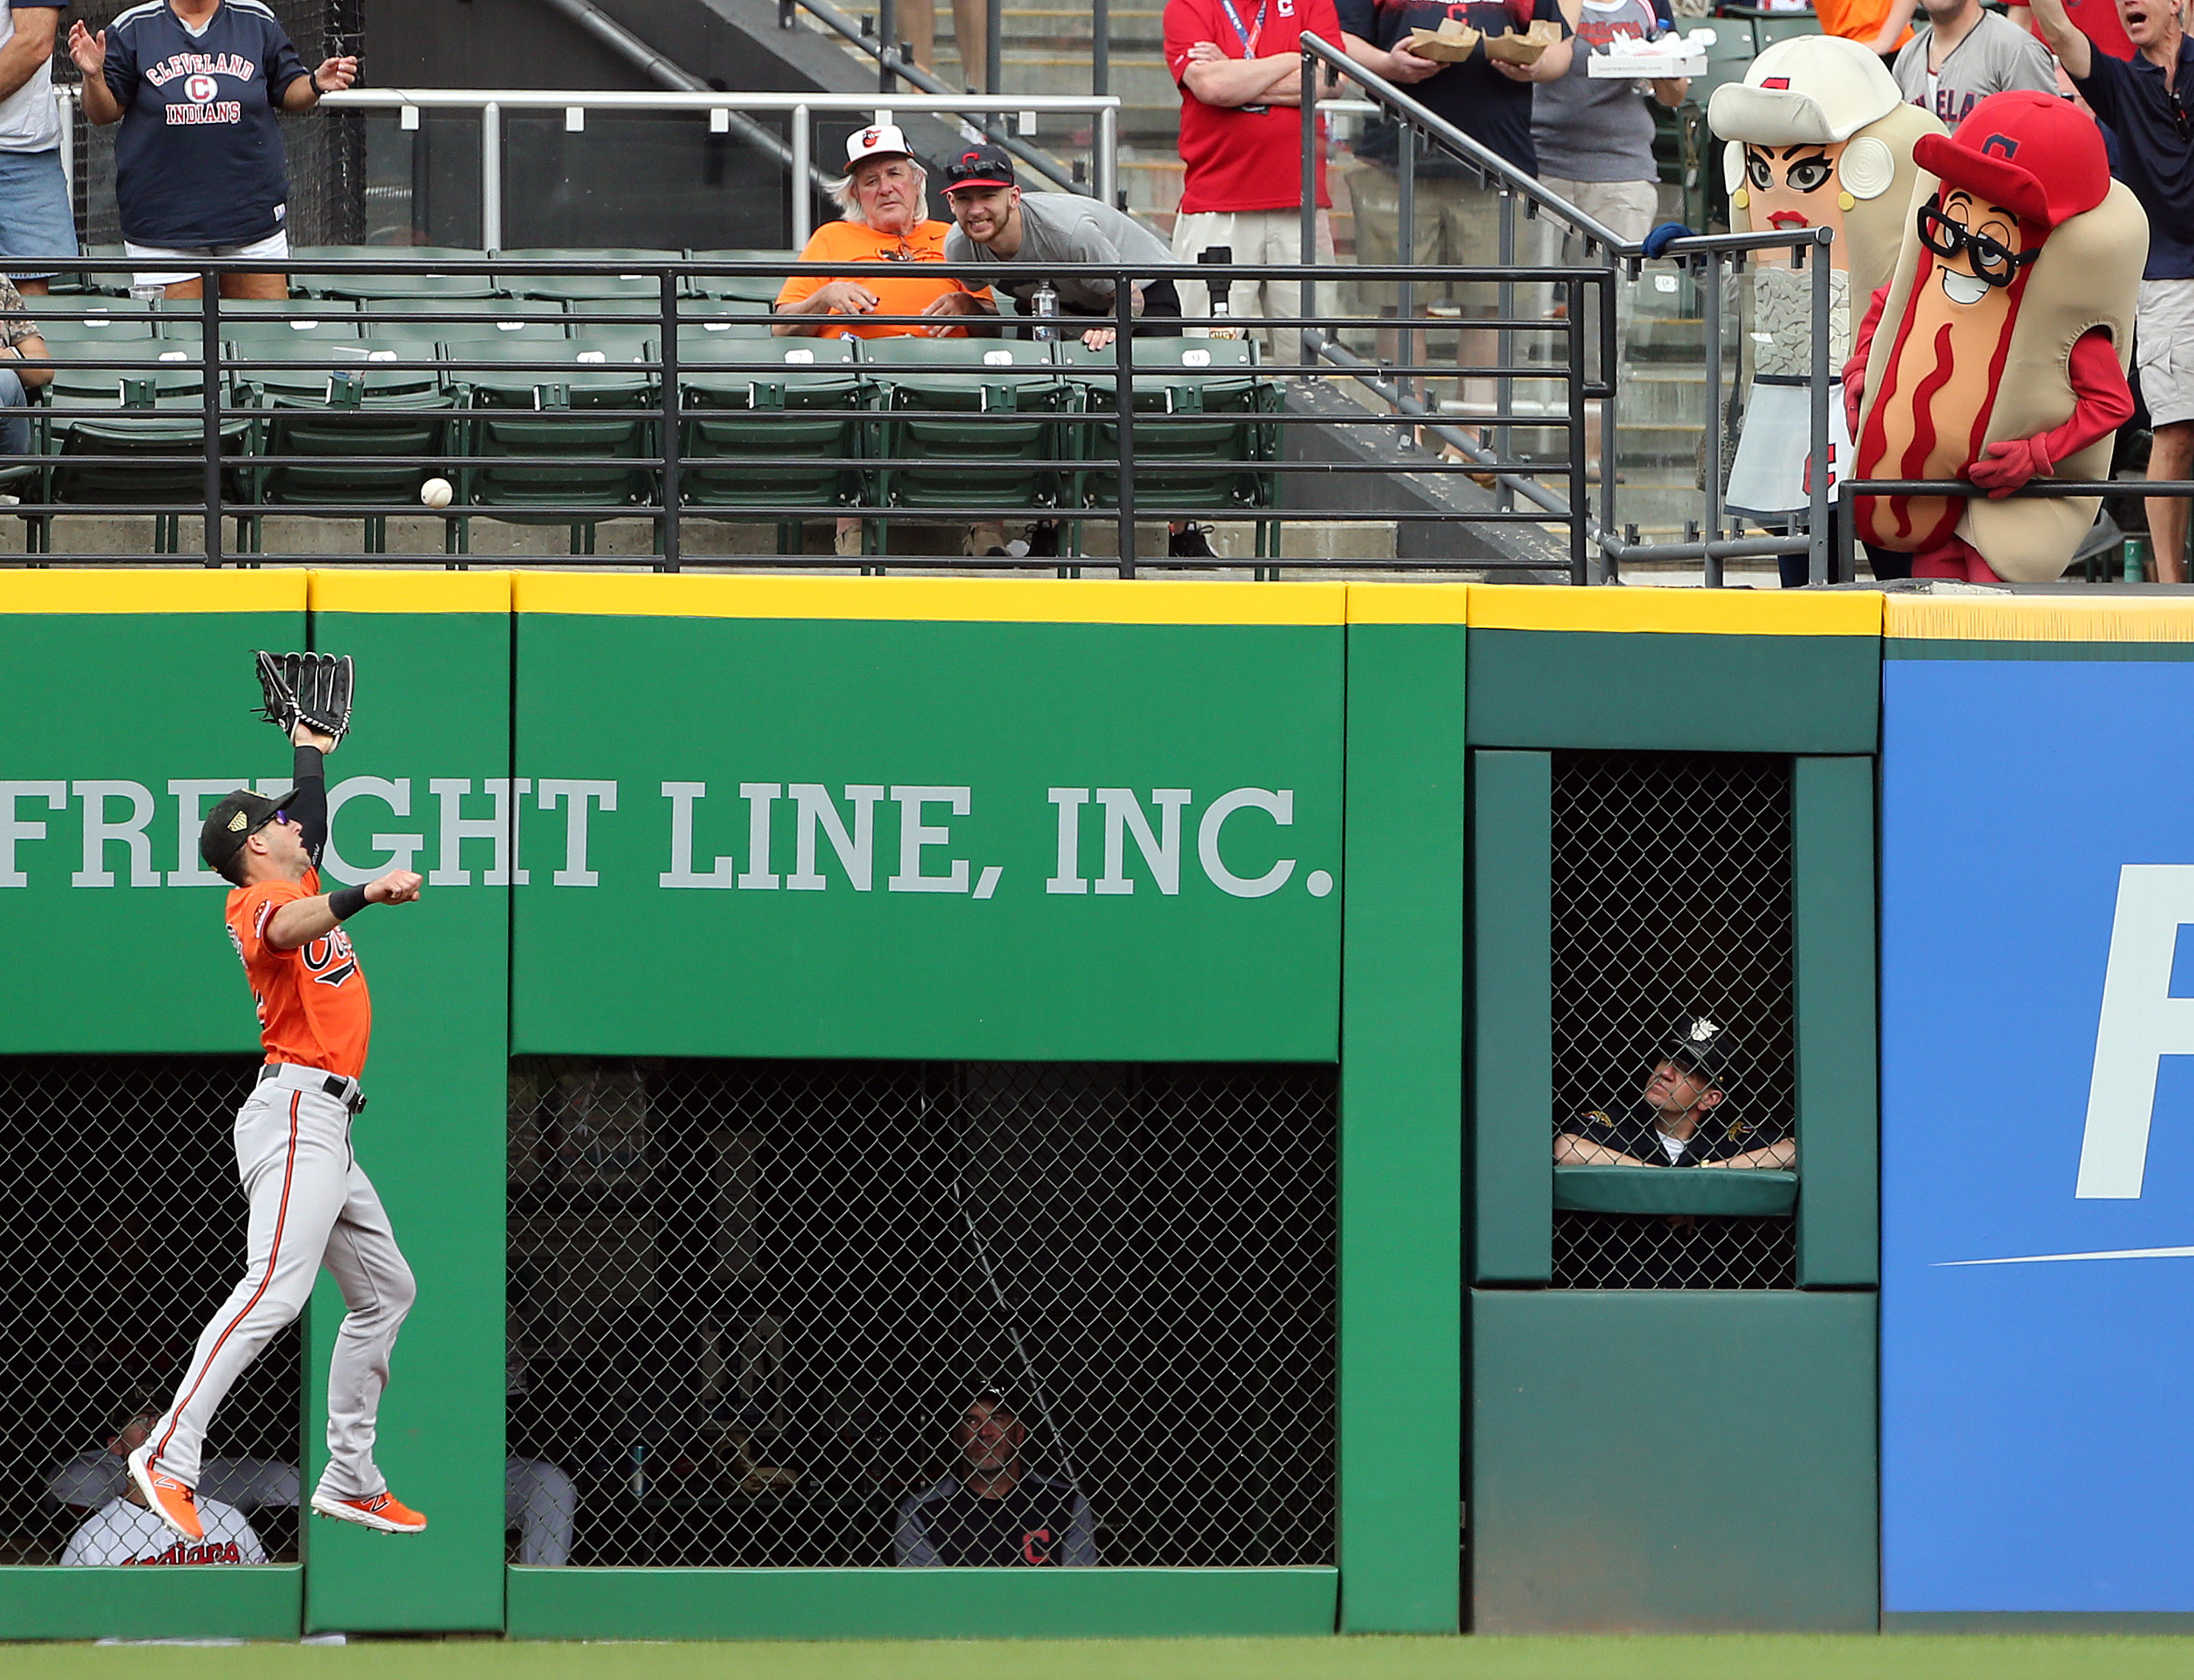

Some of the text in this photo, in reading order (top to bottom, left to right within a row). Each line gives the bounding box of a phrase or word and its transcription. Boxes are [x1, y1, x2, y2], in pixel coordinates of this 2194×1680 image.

[146, 53, 254, 86] CLEVELAND
[190, 78, 210, 100] C
[166, 101, 241, 125] INDIANS
[1191, 352, 1200, 363] 9
[0, 775, 1334, 900] FREGHT LINE, INC.
[1022, 1528, 1051, 1565] C
